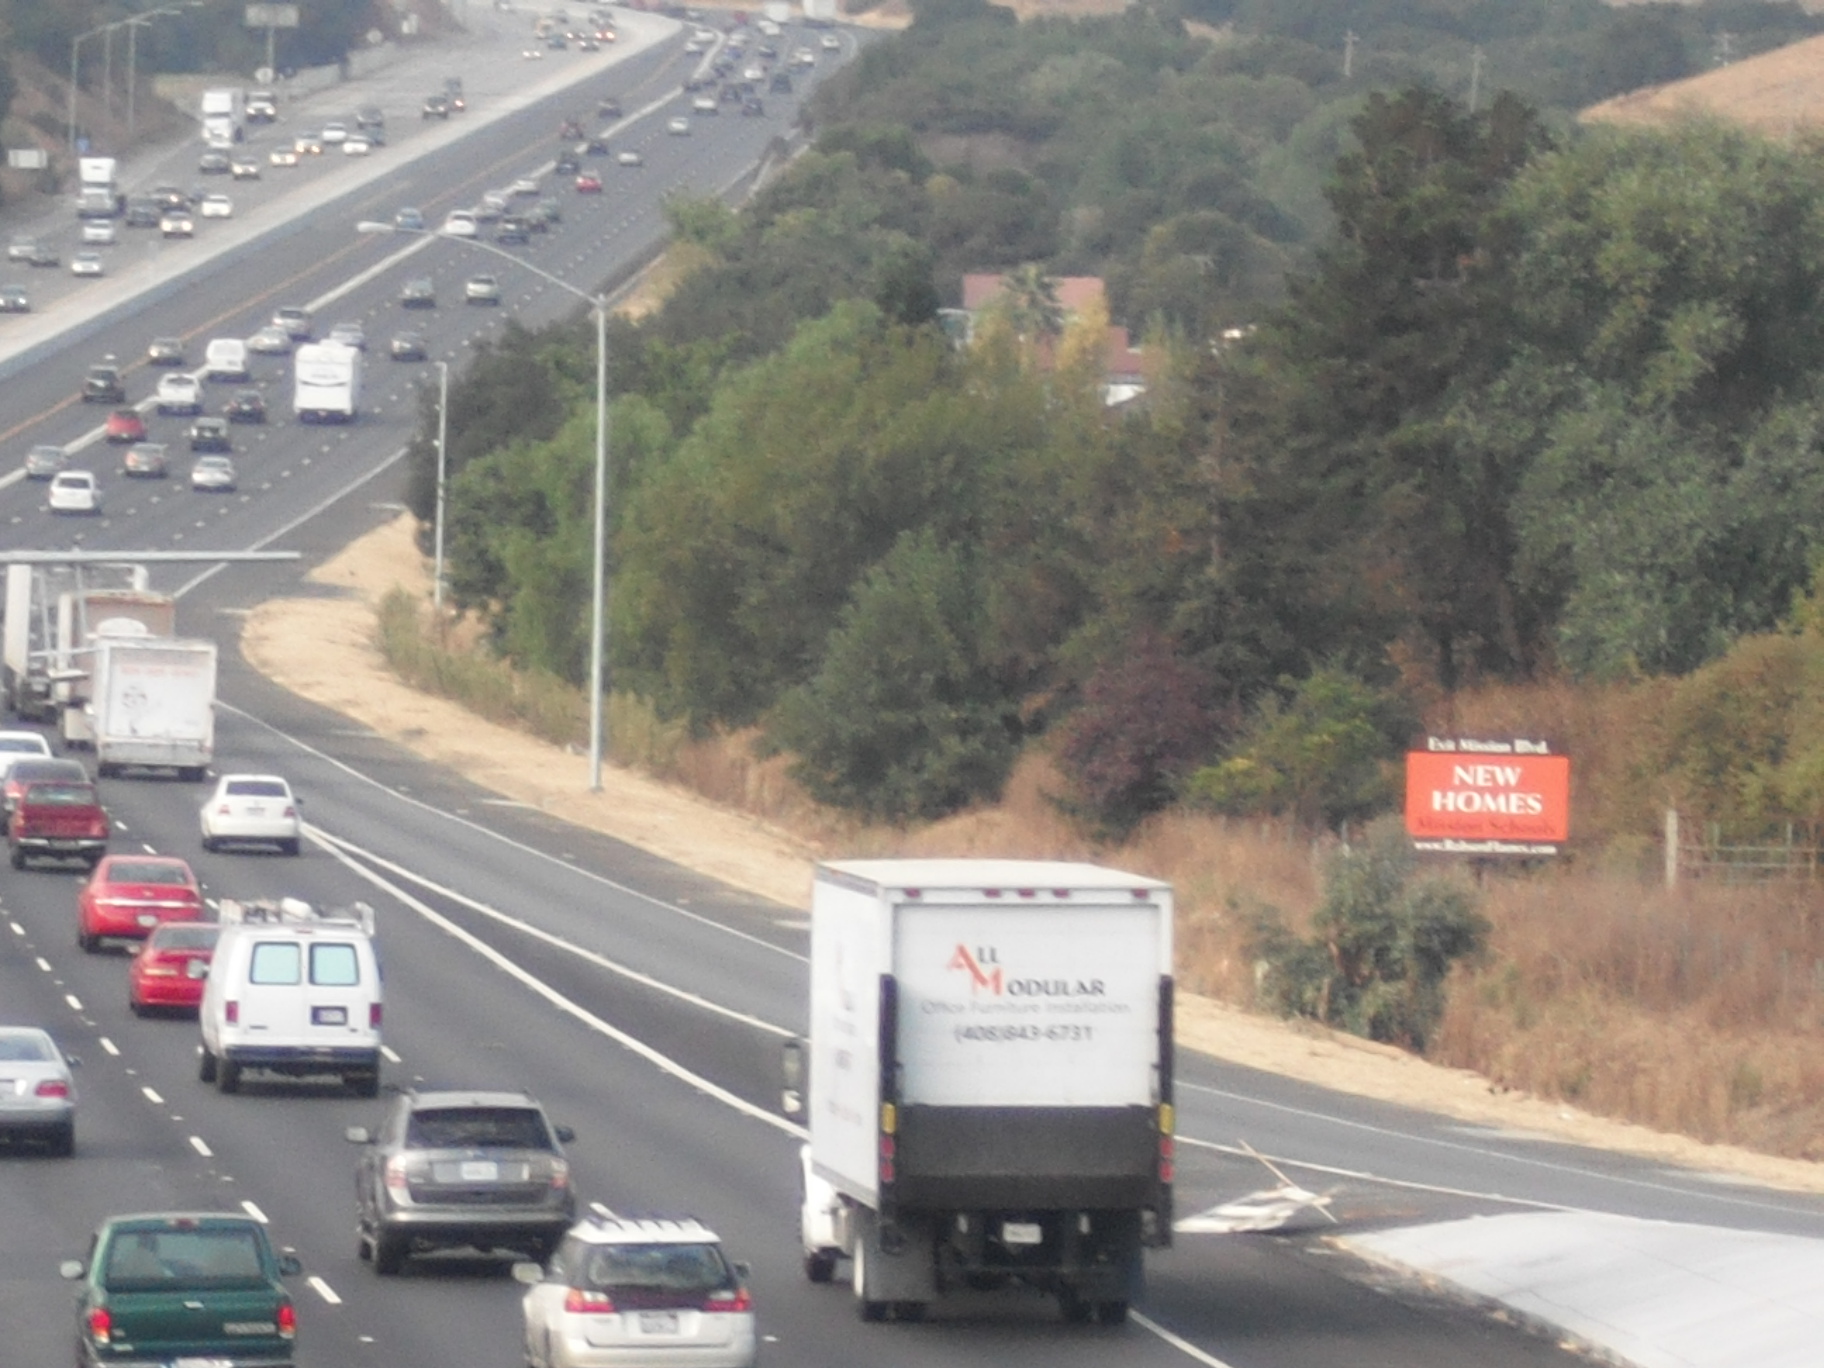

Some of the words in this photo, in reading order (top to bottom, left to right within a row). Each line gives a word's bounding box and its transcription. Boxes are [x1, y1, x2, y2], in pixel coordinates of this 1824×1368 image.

[1428, 737, 1456, 751] Exit
[1453, 765, 1522, 786] NEW
[1432, 790, 1543, 815] HOMES
[921, 1001, 965, 1014] Office
[970, 1001, 1041, 1014] Furniture
